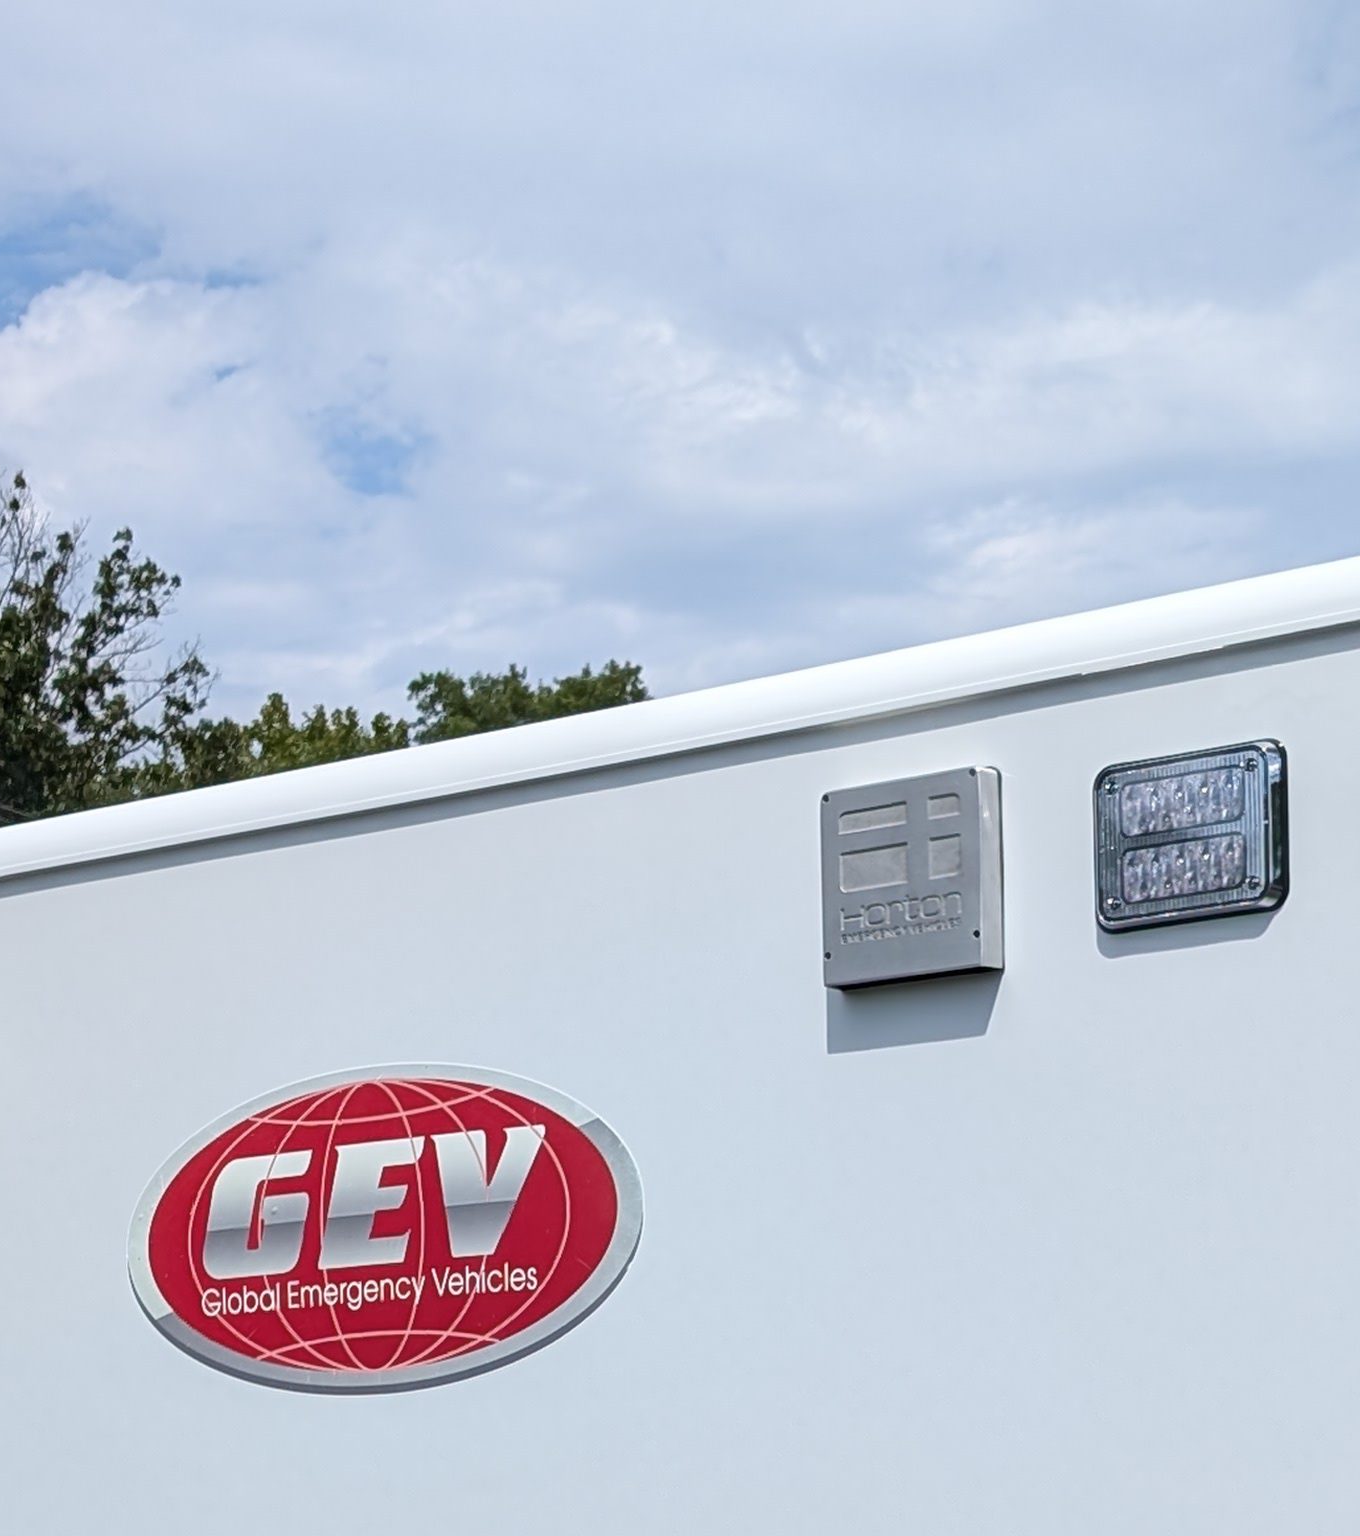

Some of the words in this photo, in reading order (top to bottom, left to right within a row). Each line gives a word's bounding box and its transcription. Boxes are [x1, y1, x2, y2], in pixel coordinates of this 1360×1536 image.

[838, 890, 963, 932] Horton
[202, 1124, 546, 1280] GEV
[200, 1282, 281, 1317] Global
[287, 1271, 426, 1315] Emergency
[431, 1261, 538, 1295] Vehicles
